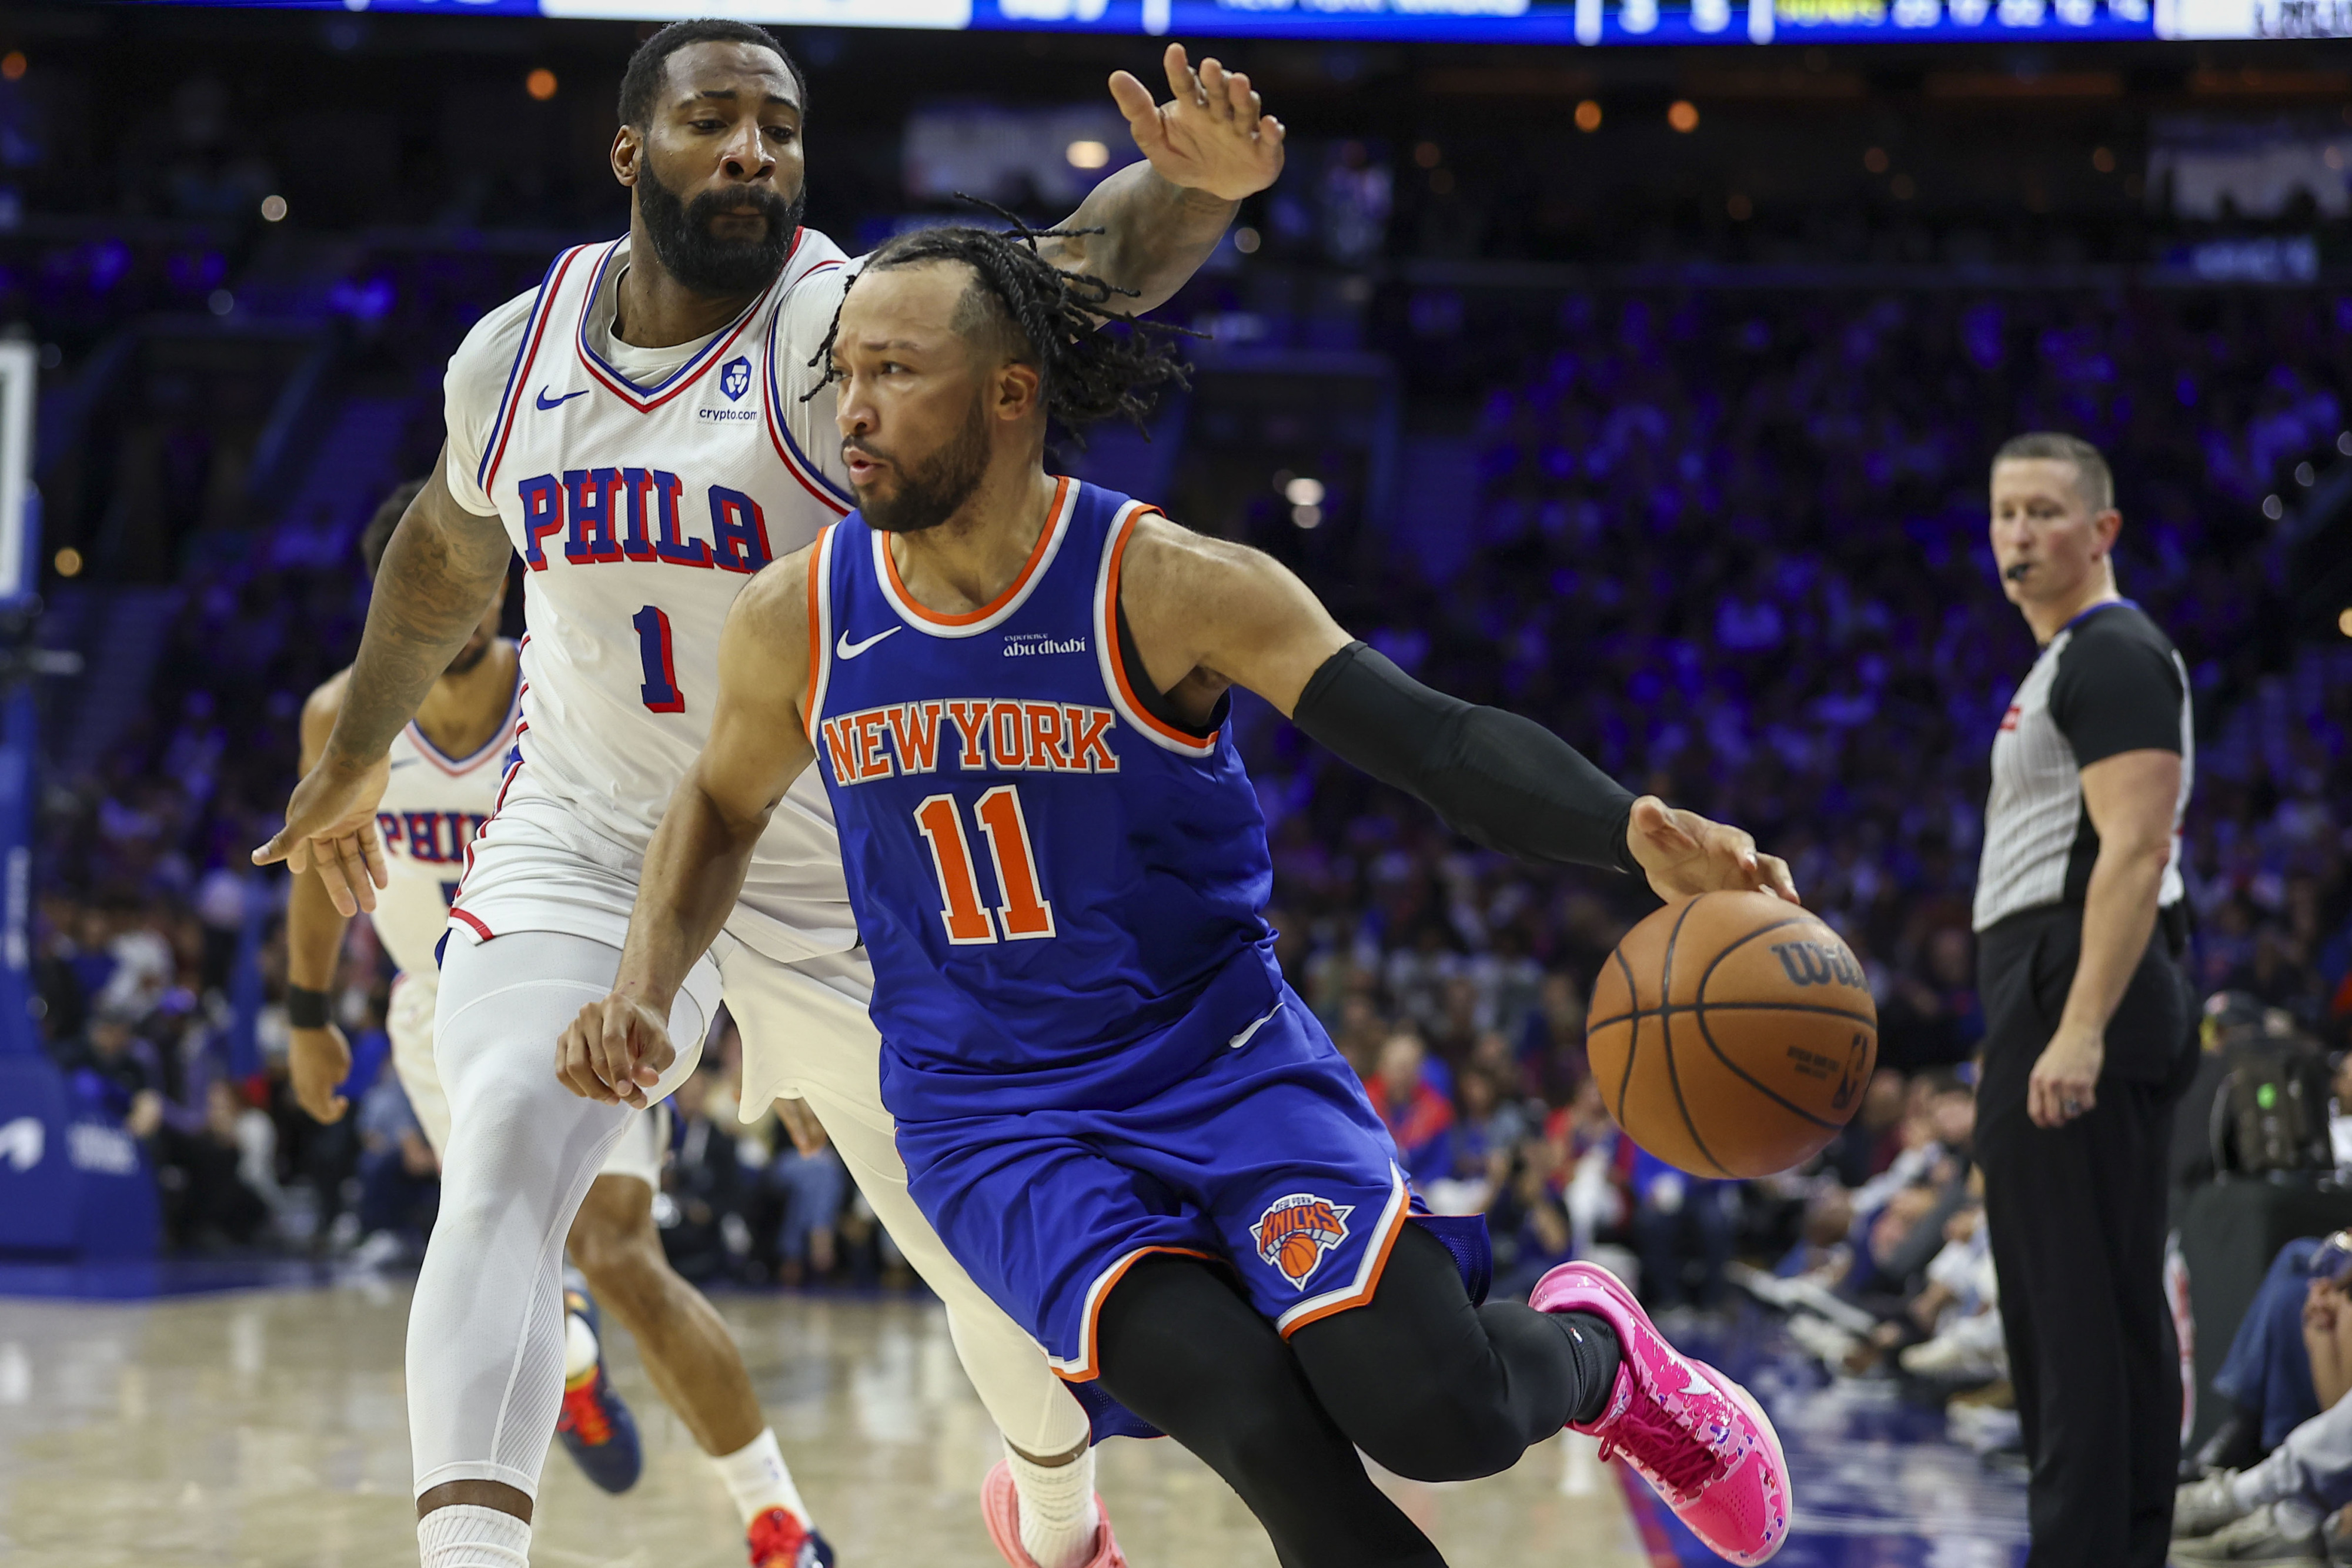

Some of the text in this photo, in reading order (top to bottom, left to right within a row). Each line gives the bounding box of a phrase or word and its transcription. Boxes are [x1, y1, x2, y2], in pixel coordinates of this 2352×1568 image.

[699, 409, 757, 421] crypto.com
[519, 467, 772, 574] PHILA
[633, 605, 684, 713] 1
[1003, 637, 1086, 657] abu dhabi
[821, 698, 1120, 787] NEW YORK
[913, 784, 1056, 945] 11
[1260, 1202, 1344, 1255] KNICKS
